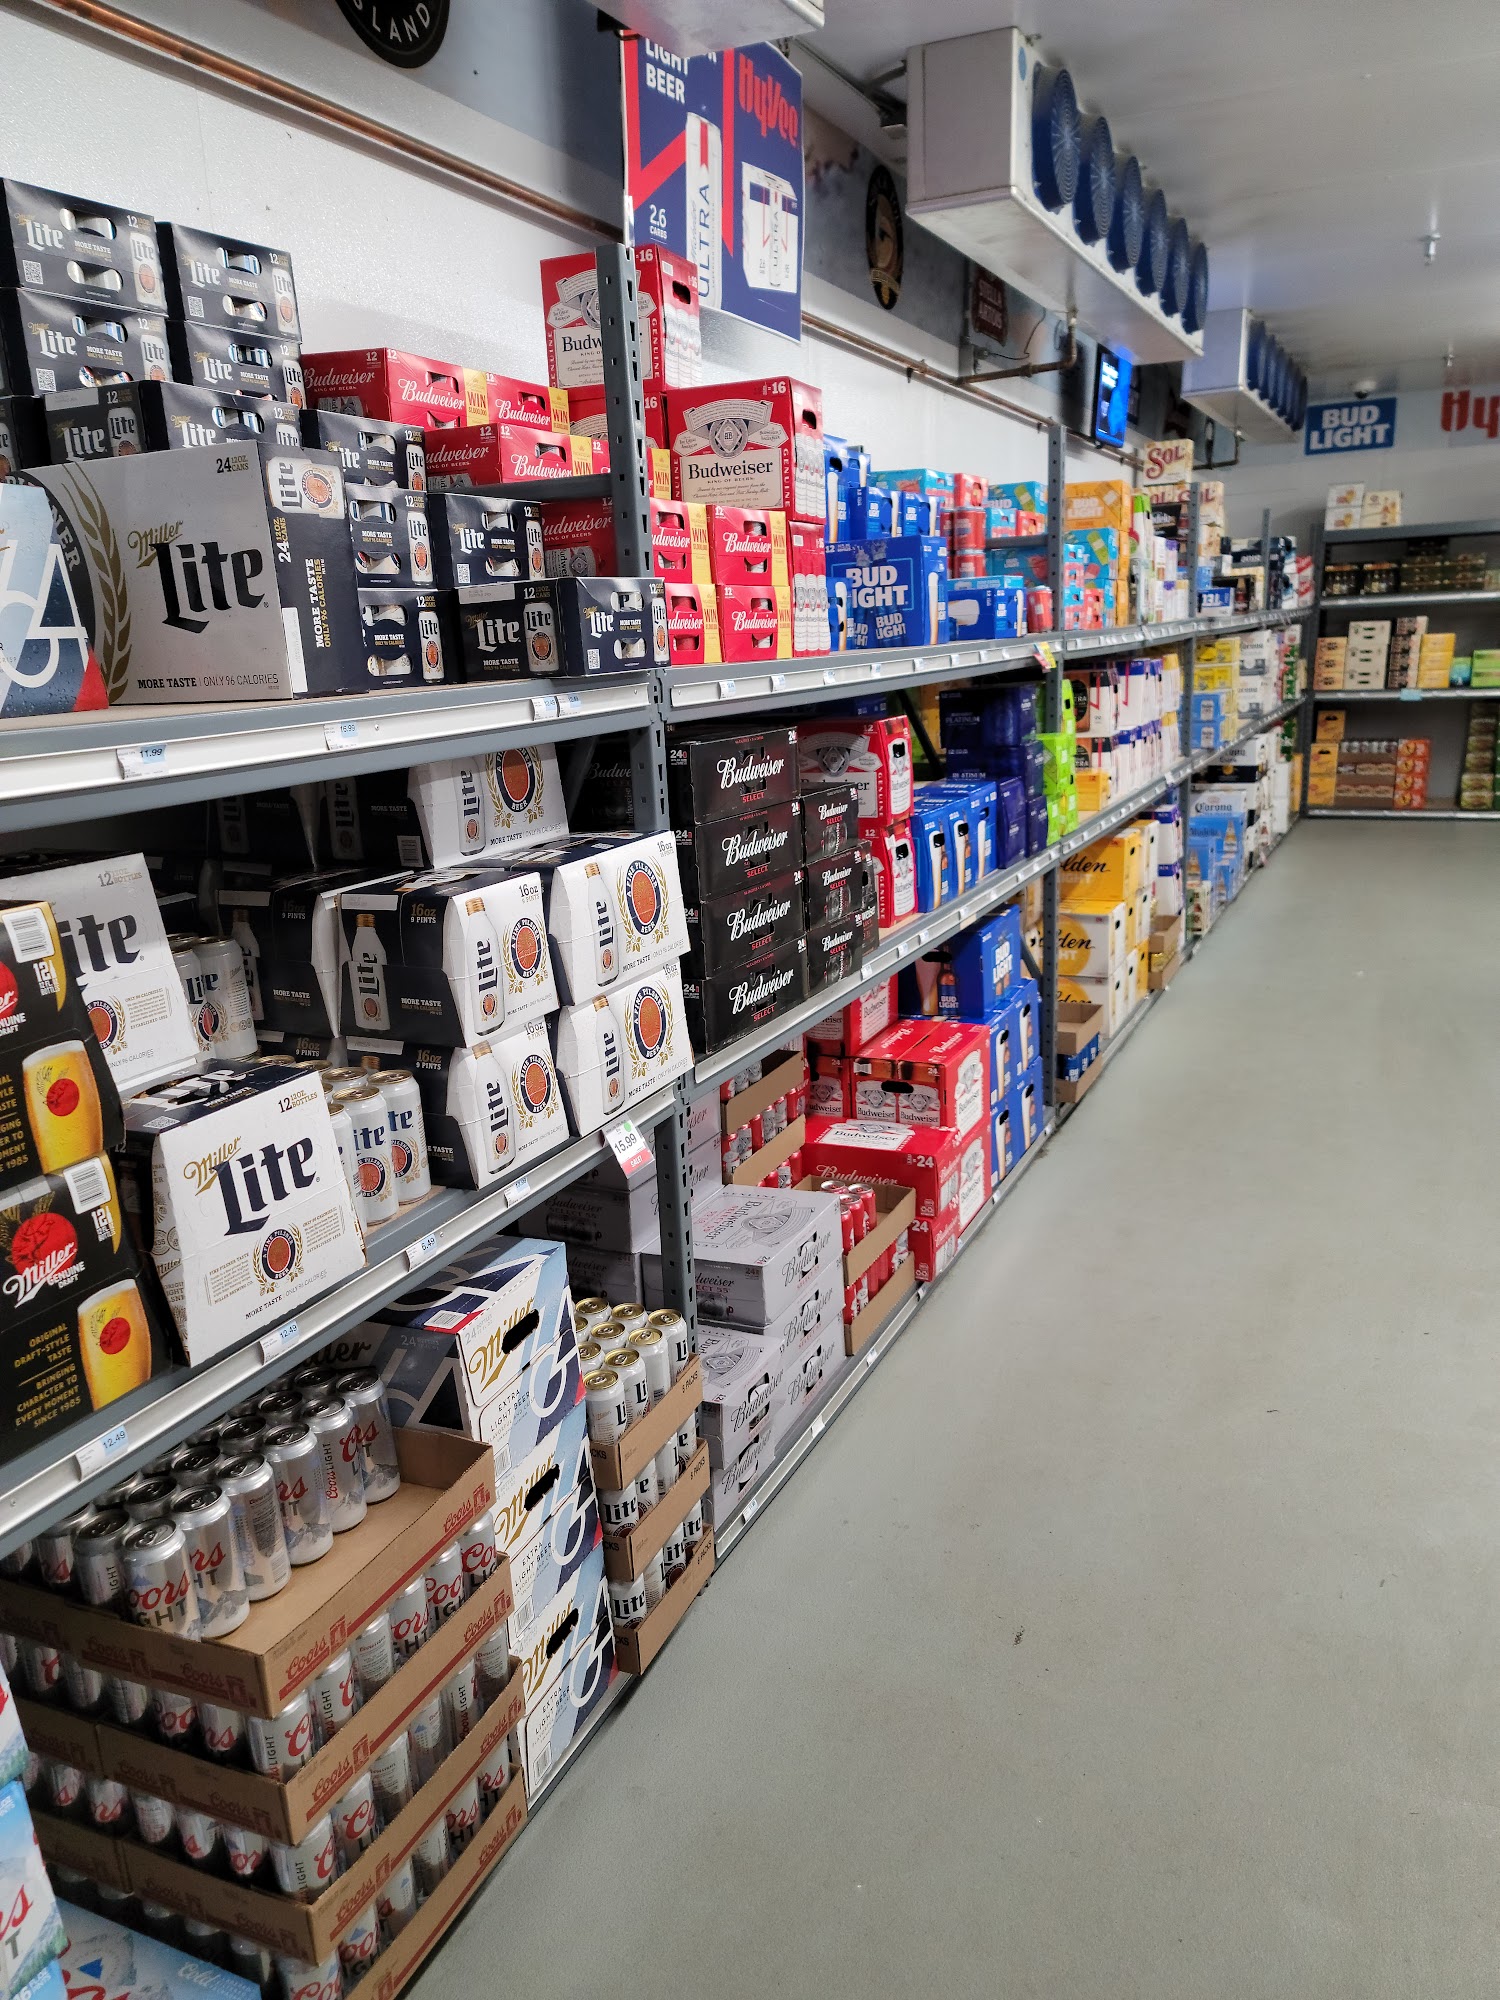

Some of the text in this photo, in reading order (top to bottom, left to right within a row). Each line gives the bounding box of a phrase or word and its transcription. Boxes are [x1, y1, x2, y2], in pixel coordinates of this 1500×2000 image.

[646, 63, 685, 103] BEER
[738, 53, 799, 148] HyVee
[127, 215, 138, 228] 12
[650, 204, 667, 227] 2.6
[25, 218, 64, 250] Lite
[650, 225, 668, 240] CARBS
[697, 184, 711, 298] ULTRA
[74, 240, 110, 254] MORE TASTE
[269, 252, 279, 264] 12
[639, 249, 653, 261] 16
[189, 257, 221, 288] Lite
[137, 317, 148, 329] 12
[38, 328, 76, 356] Lite
[280, 344, 289, 355] 12
[651, 317, 661, 379] GENUINE
[365, 351, 378, 362] 12
[386, 349, 397, 359] 12
[202, 356, 233, 384] Lite
[304, 366, 375, 390] Budweiser
[106, 391, 118, 404] 12
[398, 378, 465, 411] Budweiser
[772, 382, 786, 394] 16
[467, 391, 488, 409] WIN
[495, 398, 551, 425] Budweiser
[645, 397, 657, 408] 16
[273, 407, 284, 419] 12
[553, 408, 570, 424] WIN
[1322, 405, 1380, 429] BUD
[109, 415, 136, 440] Lite
[181, 421, 216, 447] Lite
[1310, 423, 1390, 450] LIGHT
[64, 425, 106, 462] Lite
[216, 458, 231, 473] 24
[511, 453, 573, 479] Budweiser
[688, 460, 773, 480] Budweiser
[279, 461, 302, 509] Lite
[655, 475, 669, 487] WIN
[783, 448, 791, 508] GENUINE
[405, 495, 414, 507] 12
[408, 518, 429, 540] Lite
[460, 527, 485, 553] Lite
[692, 527, 707, 543] WIN
[127, 519, 183, 568] Miller
[723, 532, 771, 553] Budweiser
[773, 536, 785, 549] WIN
[150, 541, 265, 634] Lite
[846, 566, 898, 586] BUD
[305, 558, 325, 648] MORE TASTE
[416, 596, 426, 607] 12
[851, 585, 908, 608] IGHT
[524, 609, 552, 632] Lite
[591, 612, 614, 638] Lite
[704, 610, 717, 623] WIN
[732, 610, 777, 631] Budweiser
[876, 614, 902, 628] BUD
[419, 618, 439, 641] Lite
[477, 619, 521, 652] Lite
[138, 673, 279, 689] MORE TASTE ONLY 96 CALORIES
[139, 747, 162, 758] 11.99
[716, 750, 784, 789] Budweiser
[460, 770, 481, 818] Lite
[742, 791, 765, 803] SELECT
[818, 802, 848, 819] Budweiser
[826, 814, 843, 825] SELECT
[721, 829, 788, 867] Budweiser
[747, 866, 769, 878] SELECT
[1060, 852, 1110, 872] lden
[98, 872, 113, 888] 12
[821, 866, 852, 886] Budweiser
[830, 879, 847, 890] SELECT
[519, 884, 539, 898] 16oz
[411, 903, 437, 917] 16oz
[727, 899, 791, 941] Budweiser
[595, 900, 614, 948] Lite
[56, 914, 141, 990] ite
[751, 936, 772, 950] SELECT
[822, 930, 853, 951] Budweiser
[830, 943, 848, 955] SELECT
[622, 954, 651, 972] MORE TASTE
[995, 941, 1012, 966] BUD
[359, 952, 379, 997] Lite
[477, 939, 500, 994] Lite
[992, 955, 1013, 982] LIGHT
[401, 998, 442, 1007] MORE TASTE
[729, 968, 794, 1015] Budweiser
[941, 995, 957, 1003] BUD
[754, 1006, 775, 1022] SELECT
[939, 1000, 960, 1009] LIGHT
[524, 1022, 544, 1036] 16oz
[416, 1050, 441, 1063] 16oz
[604, 1030, 620, 1078] Lite
[277, 1098, 292, 1114] 12
[487, 1080, 510, 1134] Lite
[858, 1107, 895, 1119] Budweiser
[901, 1110, 939, 1123] Budweiser
[613, 1133, 638, 1154] 15.99
[183, 1135, 242, 1196] Miller
[917, 1156, 934, 1168] 24
[816, 1164, 898, 1185] Budweiser
[212, 1137, 315, 1237] Lite
[911, 1220, 928, 1233] 24
[421, 1237, 435, 1253] 6.49
[782, 1231, 831, 1287] Budweiser
[3, 1242, 76, 1309] Miller
[47, 1261, 86, 1286] GENUINE
[58, 1274, 79, 1290] DRAFT
[245, 1305, 263, 1320] MORE
[264, 1295, 283, 1310] TASTE
[784, 1288, 832, 1344] Budweiser
[29, 1322, 68, 1348] ORIGINAL
[280, 1325, 298, 1339] 12.49
[14, 1334, 71, 1368] DRAFT-STYLE
[47, 1345, 73, 1363] TASTE
[469, 1297, 535, 1394] Miller
[36, 1363, 76, 1390] BRINGING
[17, 1374, 78, 1412] CHARACTER TO
[497, 1389, 520, 1412] EXTRA
[15, 1385, 79, 1426] EVERY MOMENT
[34, 1396, 81, 1428] SINCE 1985
[490, 1409, 513, 1432] LIGHT
[514, 1390, 531, 1413] BEER
[102, 1431, 126, 1449] 12.49
[322, 1443, 338, 1499] Coors LIGHT
[443, 1497, 473, 1533] Coors
[495, 1456, 559, 1552] Miller
[603, 1498, 637, 1524] Lite
[522, 1541, 543, 1567] EXTRA
[129, 1571, 190, 1610] oors
[613, 1592, 645, 1620] Lite
[464, 1608, 494, 1643] Coors
[286, 1633, 329, 1680] Coors
[481, 1717, 508, 1753] Coors
[313, 1757, 351, 1801] Coors
[336, 1878, 373, 1922] Coors
